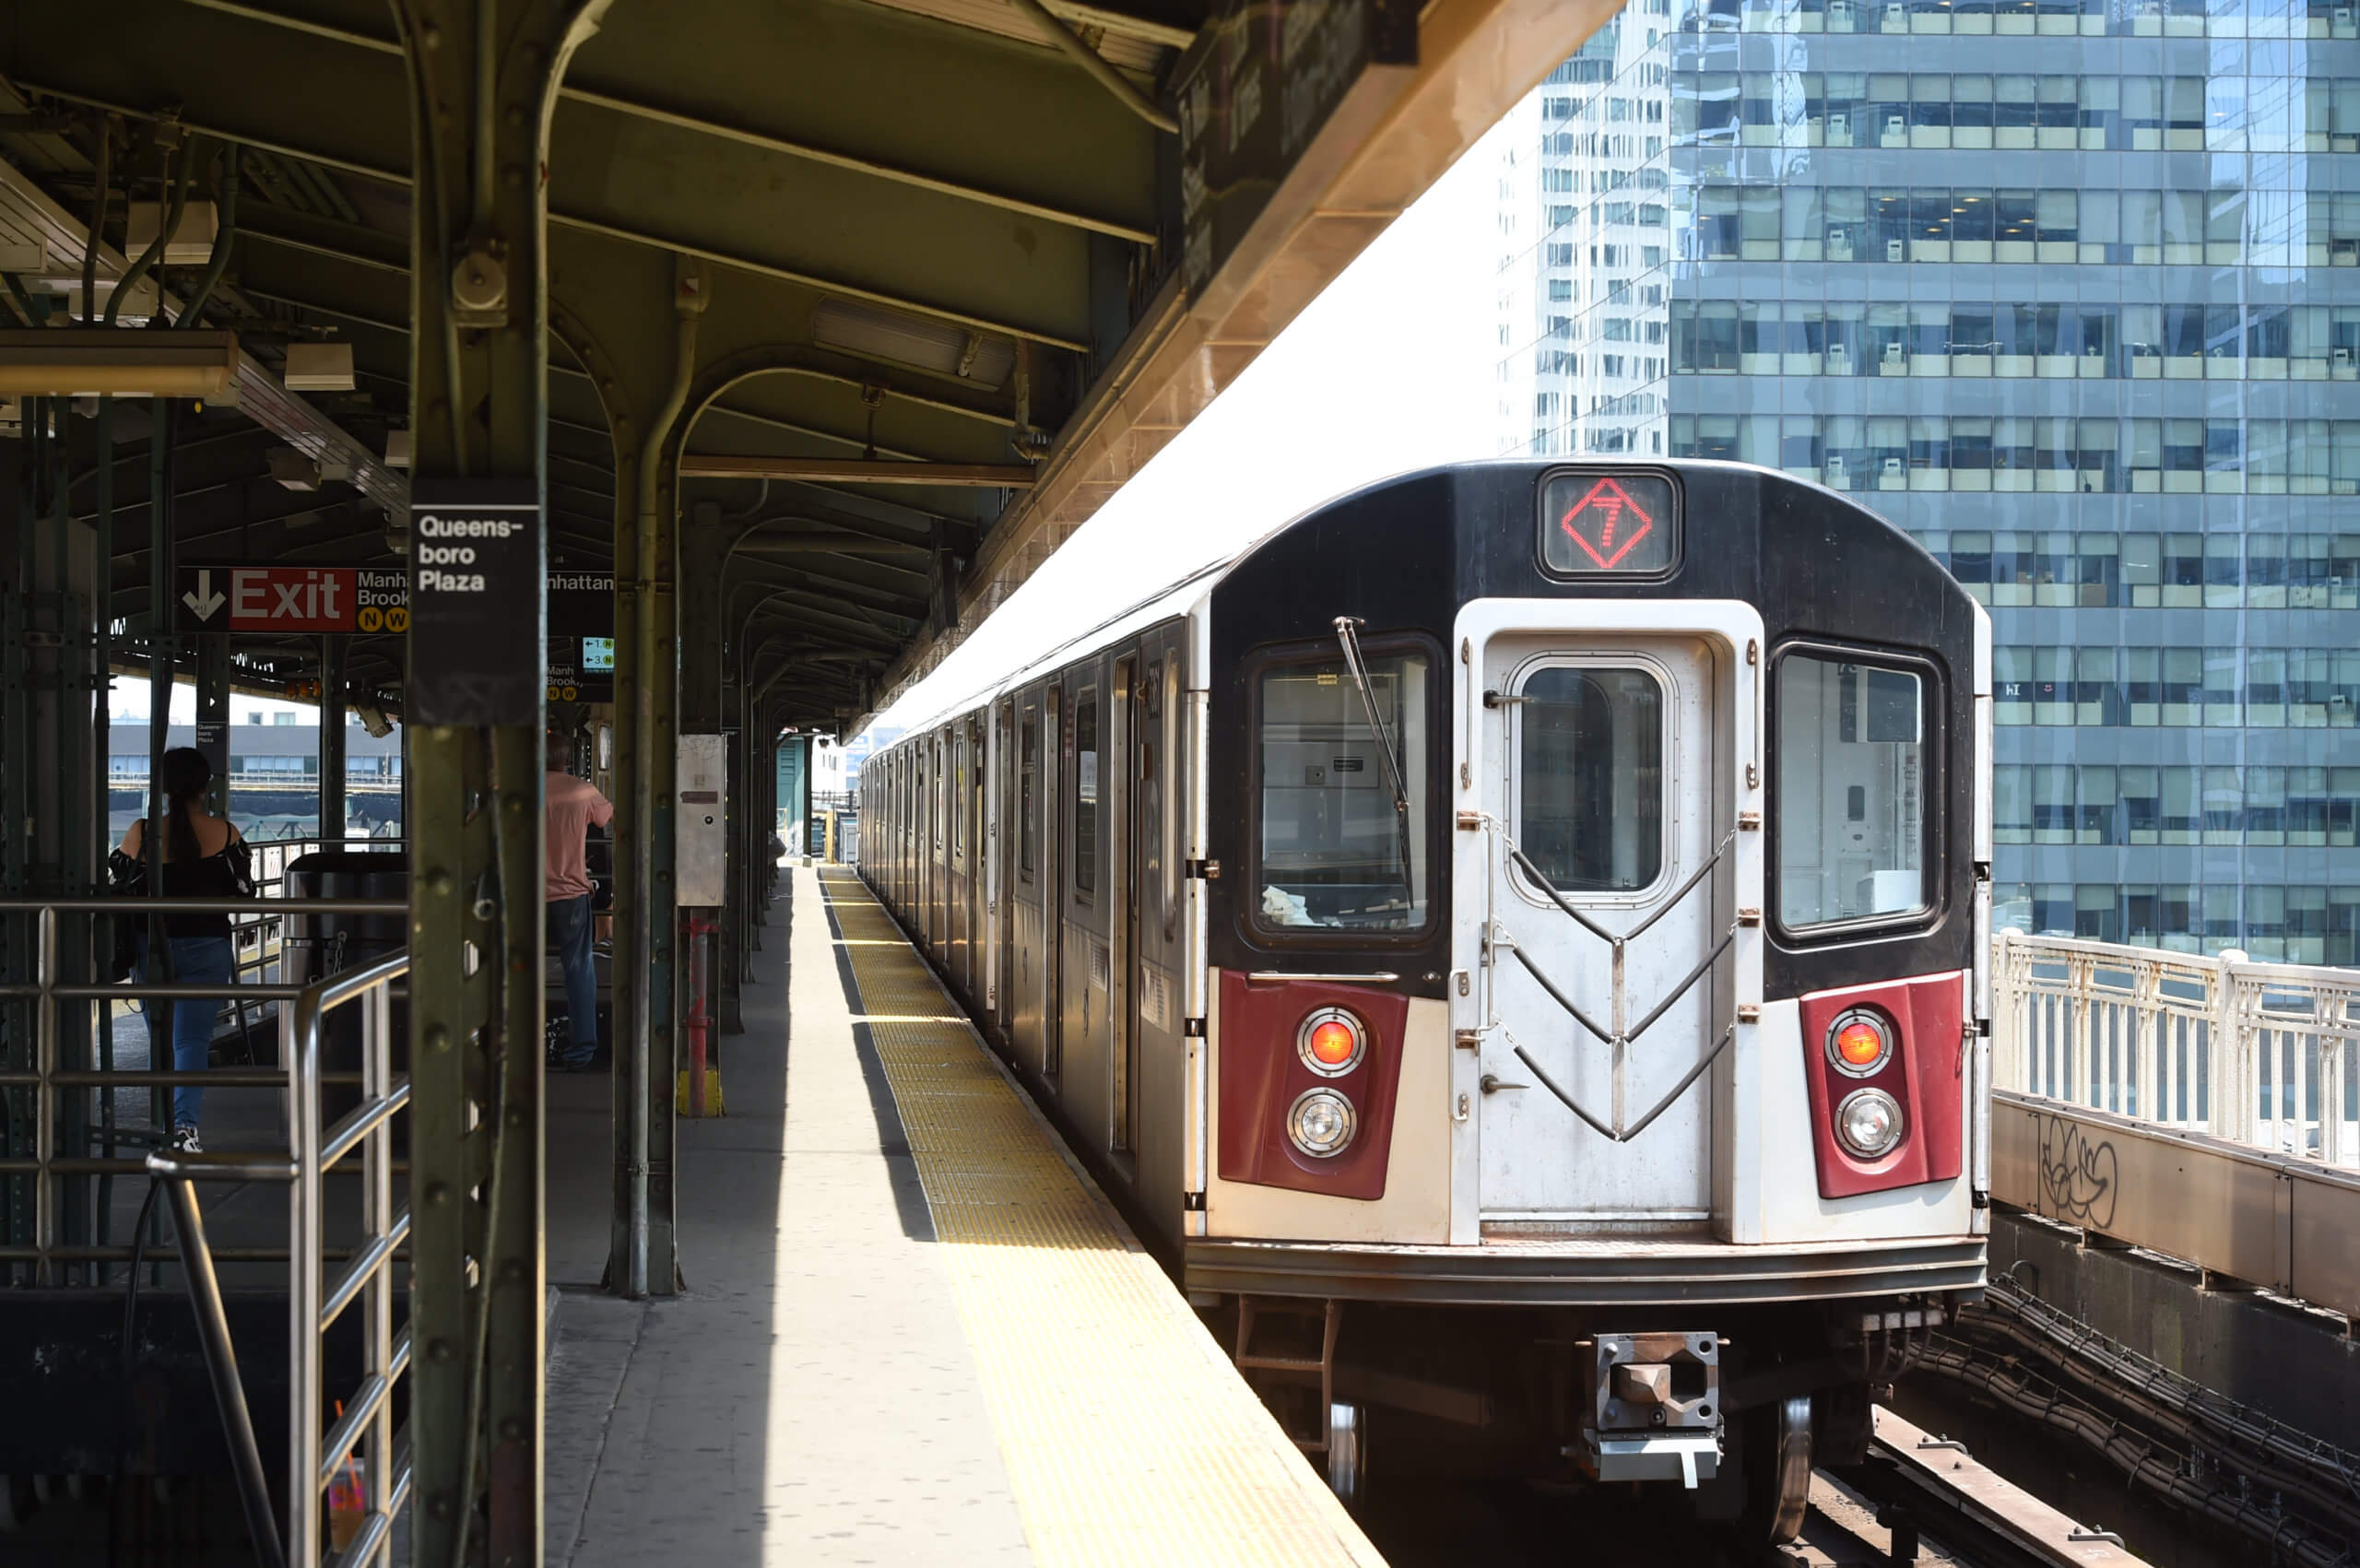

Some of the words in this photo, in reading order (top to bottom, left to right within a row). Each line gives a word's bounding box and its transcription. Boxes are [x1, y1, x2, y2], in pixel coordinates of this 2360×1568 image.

[419, 515, 524, 537] Queens-
[1592, 497, 1622, 547] 7
[419, 543, 476, 564] boro
[358, 572, 409, 588] Manh
[419, 570, 485, 591] Plaza
[232, 570, 340, 619] Exit
